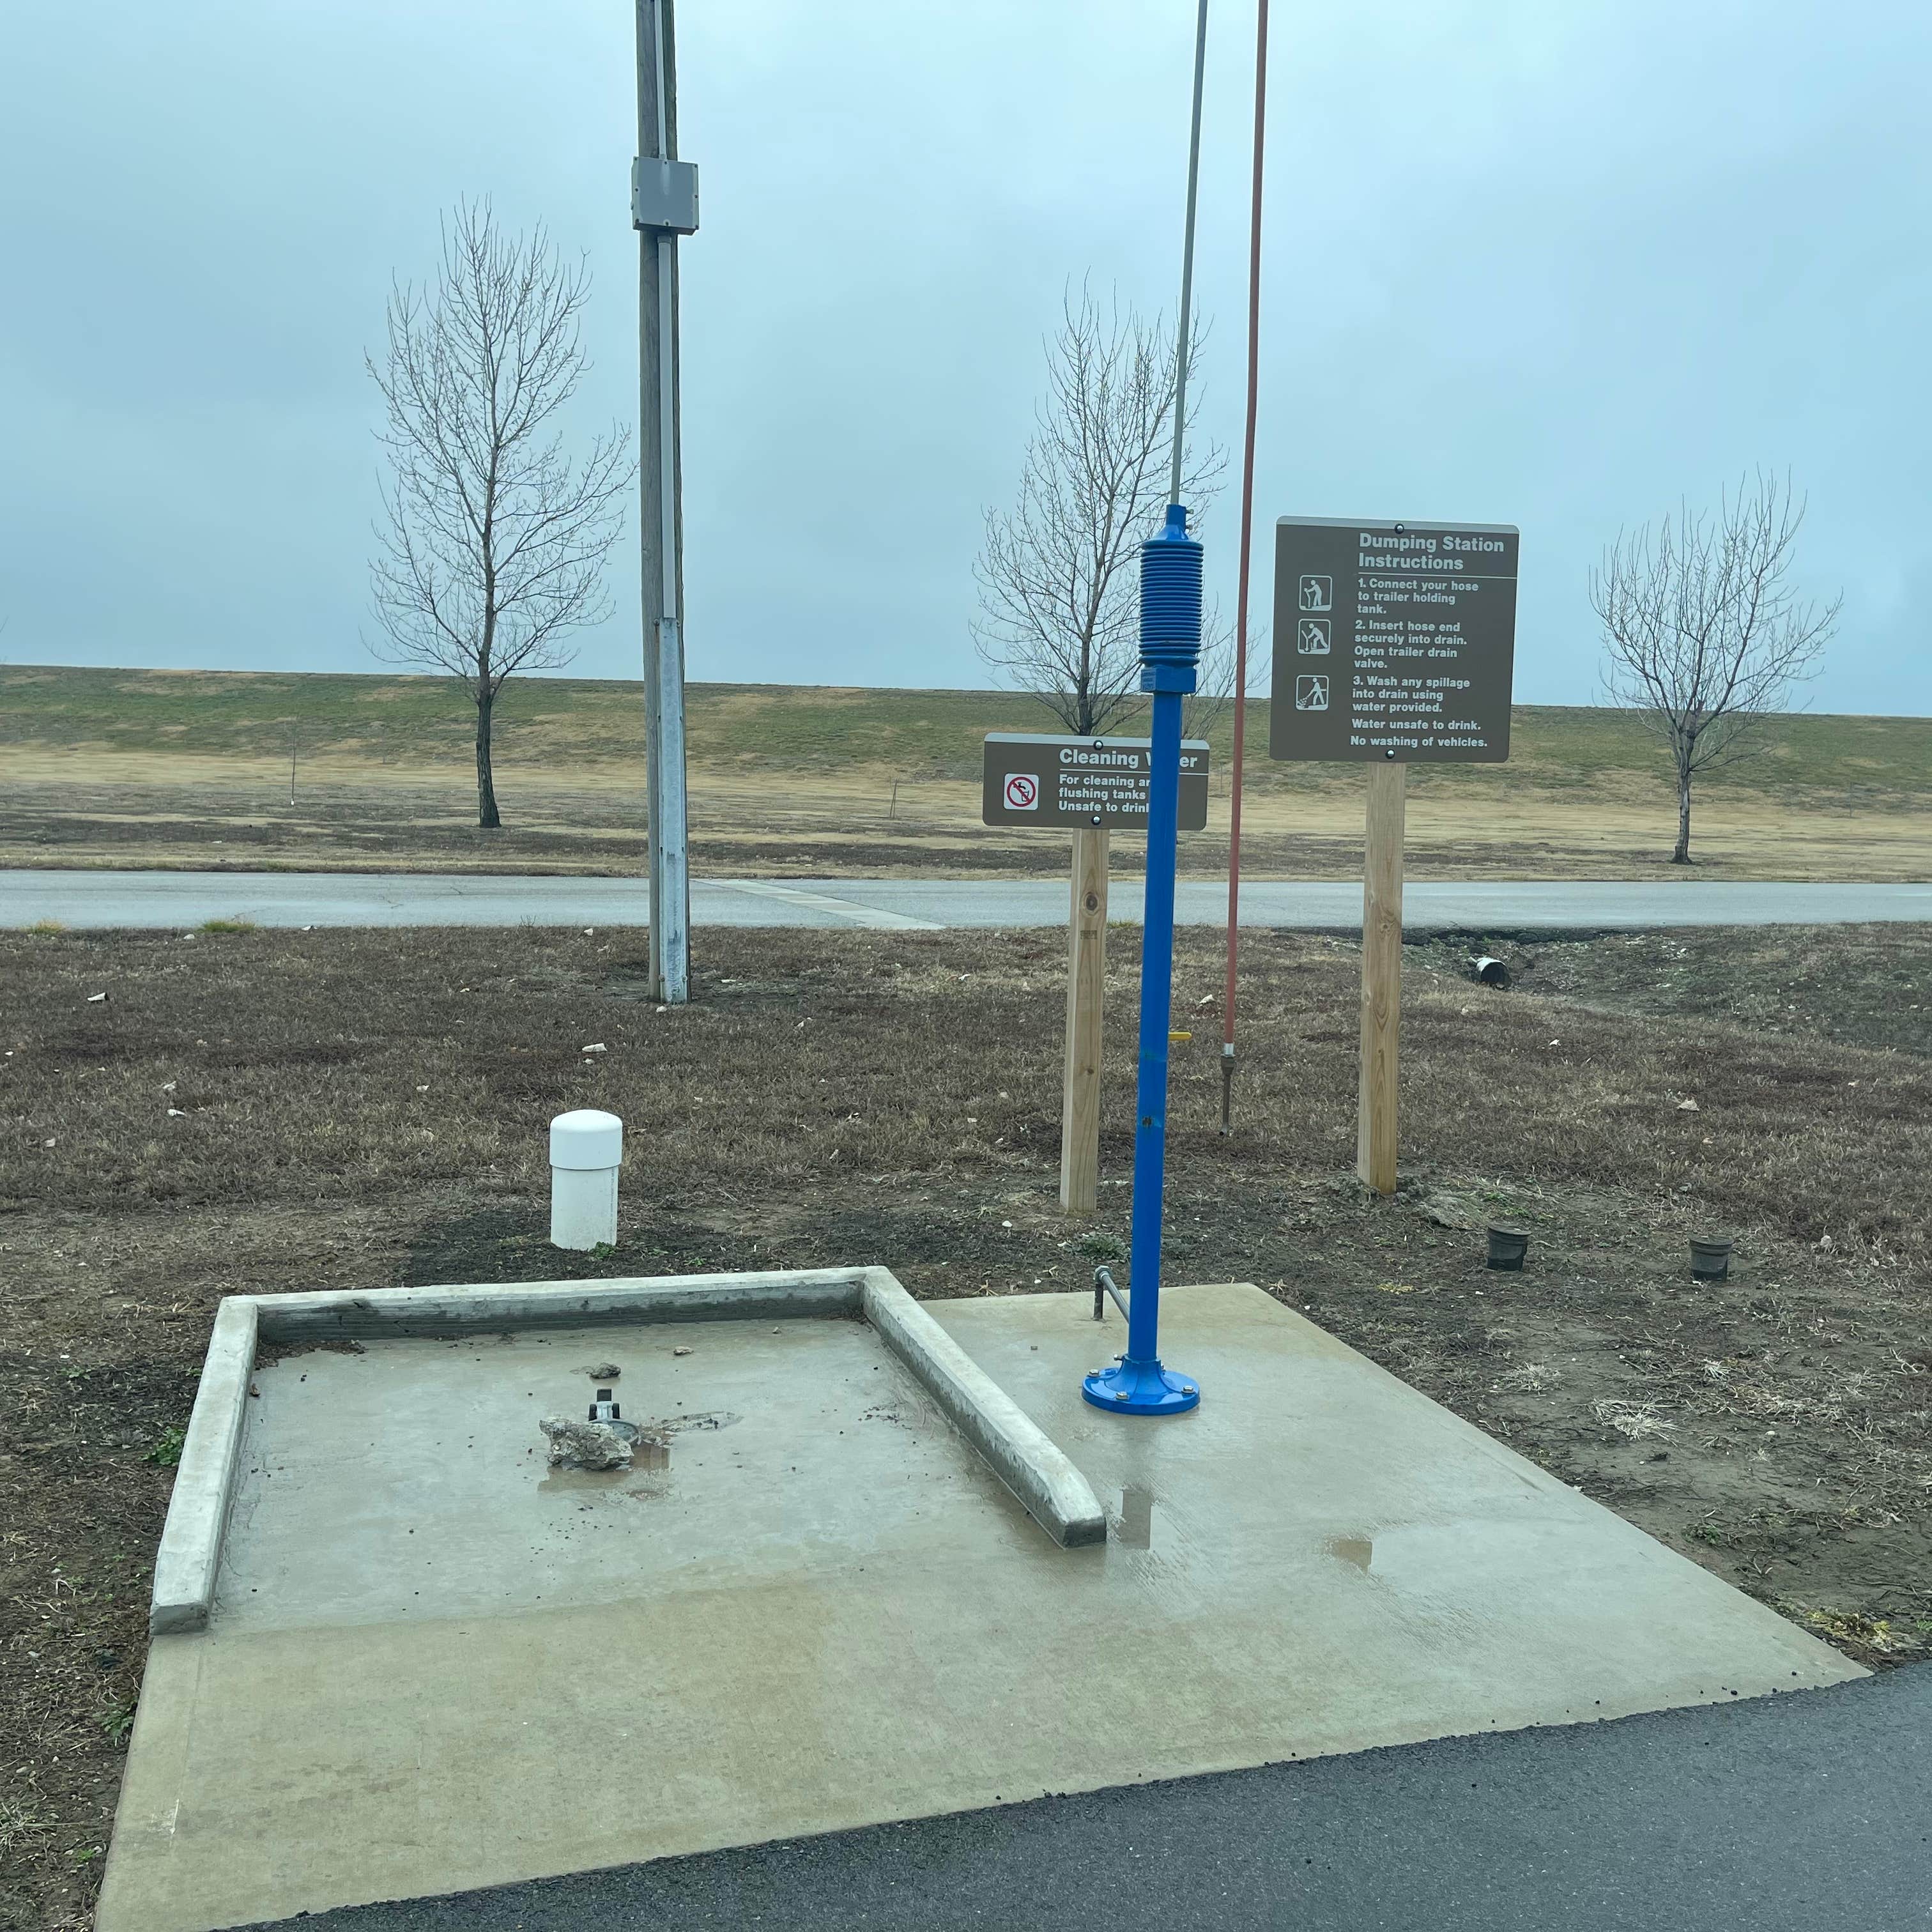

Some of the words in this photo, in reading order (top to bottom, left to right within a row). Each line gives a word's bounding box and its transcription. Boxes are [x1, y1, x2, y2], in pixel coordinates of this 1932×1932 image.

[1360, 533, 1436, 553] Dumping
[1443, 536, 1503, 551] Station
[1360, 553, 1463, 569] Instructions
[1358, 578, 1366, 587] 1.
[1370, 578, 1417, 588] Connect
[1422, 583, 1447, 591] your
[1452, 581, 1478, 590] hose
[1358, 592, 1369, 600] to
[1374, 592, 1409, 601] trailer
[1413, 592, 1455, 604] holding
[1358, 604, 1386, 613] tank.
[1356, 620, 1365, 629] 2.
[1370, 620, 1403, 630] Insert
[1408, 621, 1435, 631] hose
[1439, 622, 1460, 631] end
[1355, 634, 1404, 645] securely
[1409, 634, 1430, 643] into
[1435, 635, 1466, 644] drain.
[1354, 646, 1384, 657] Open
[1389, 647, 1423, 656] trailer
[1428, 648, 1457, 657] drain
[1354, 659, 1387, 668] valve.
[1353, 676, 1363, 685] 3.
[1367, 676, 1397, 686] Wash
[1402, 679, 1422, 688] any
[1426, 678, 1469, 689] spillage
[1353, 689, 1374, 698] into
[1379, 689, 1407, 698] drain
[1413, 690, 1443, 701] using
[1353, 702, 1385, 710] water
[1390, 703, 1442, 713] provided.
[1352, 719, 1385, 728] Water
[1390, 720, 1428, 729] unsafe
[1432, 721, 1444, 729] to
[1448, 721, 1480, 730] drink.
[1351, 736, 1366, 745] No
[1370, 737, 1418, 747] washing
[1422, 737, 1433, 746] of
[1438, 737, 1487, 746] vehicles.
[1060, 749, 1138, 769] Cleaning
[1060, 774, 1079, 784] For
[1083, 776, 1134, 788] cleaning
[1059, 788, 1108, 801] flushing
[1113, 790, 1146, 799] tanks
[1059, 801, 1101, 811] Unsafe
[1106, 802, 1117, 811] to
